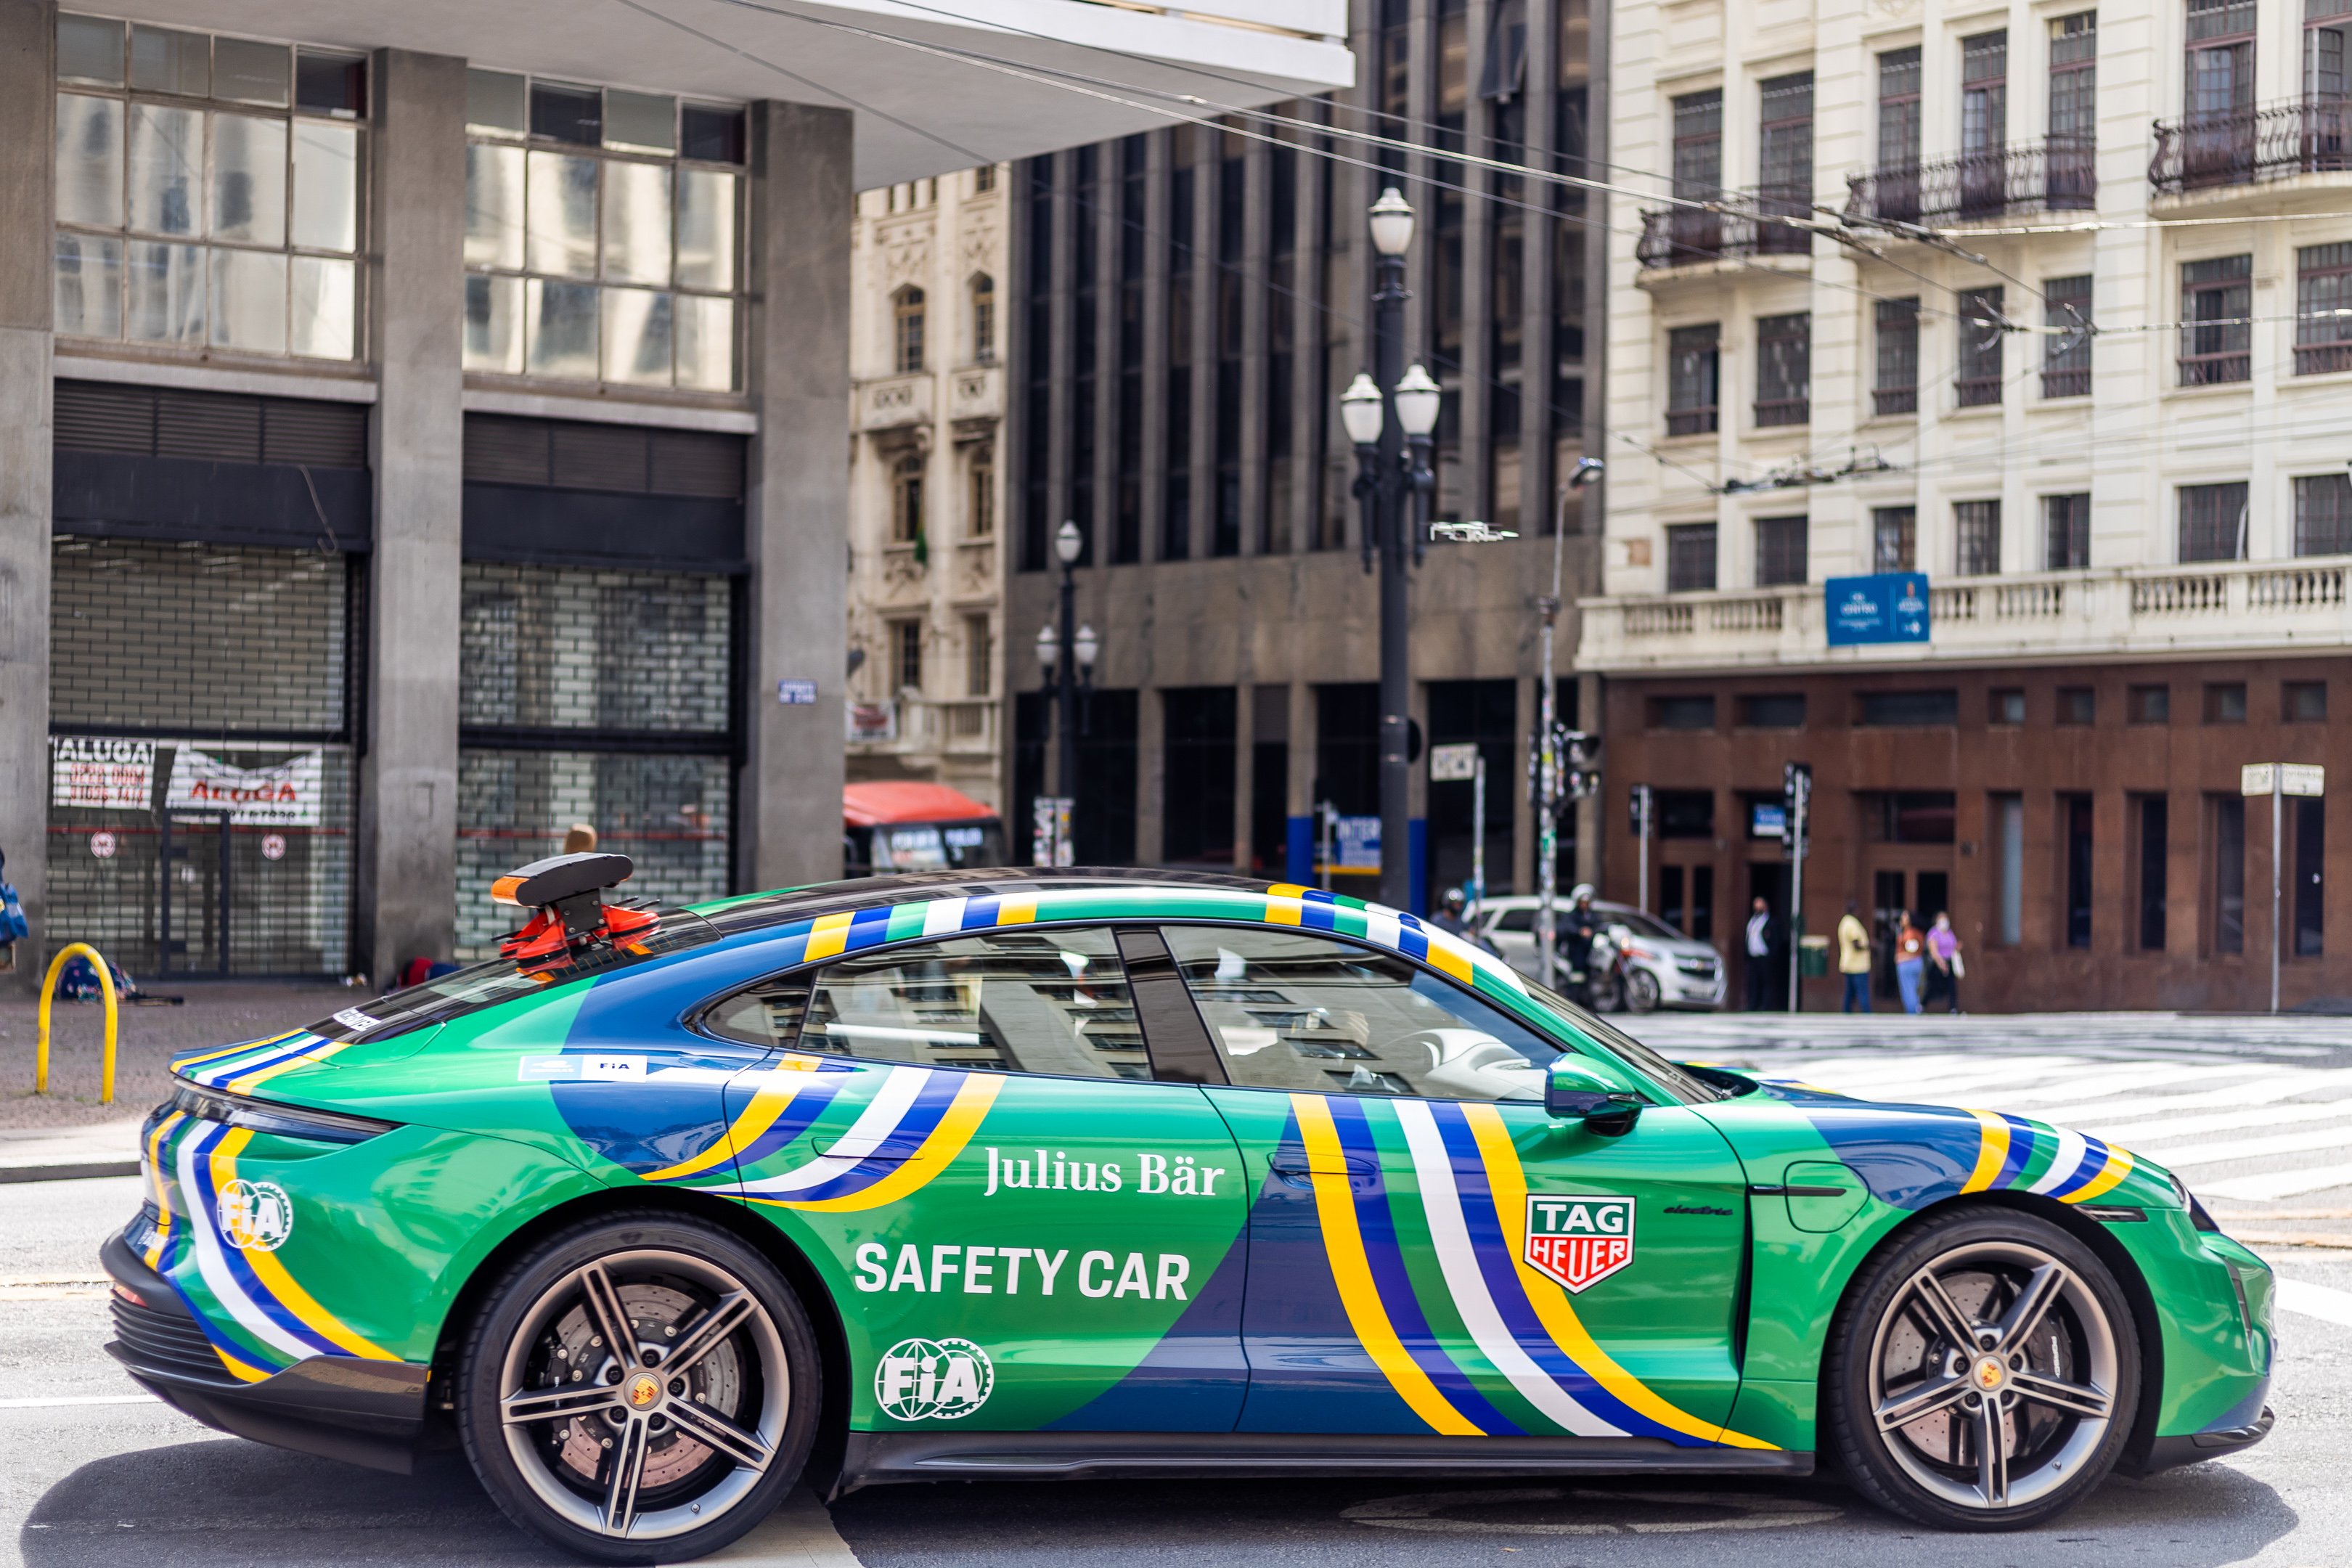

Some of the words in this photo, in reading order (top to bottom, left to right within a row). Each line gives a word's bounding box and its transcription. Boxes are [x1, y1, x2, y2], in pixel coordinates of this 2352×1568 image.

[58, 738, 150, 764] ALUGA
[191, 780, 296, 802] ALUGA
[984, 1147, 1122, 1196] Julius
[1137, 1153, 1225, 1196] Bär
[1537, 1204, 1624, 1233] TAG
[854, 1242, 1069, 1296] SAFETY
[1078, 1250, 1191, 1301] CAR
[1532, 1239, 1626, 1283] HEUER
[882, 1356, 980, 1404] FiA
